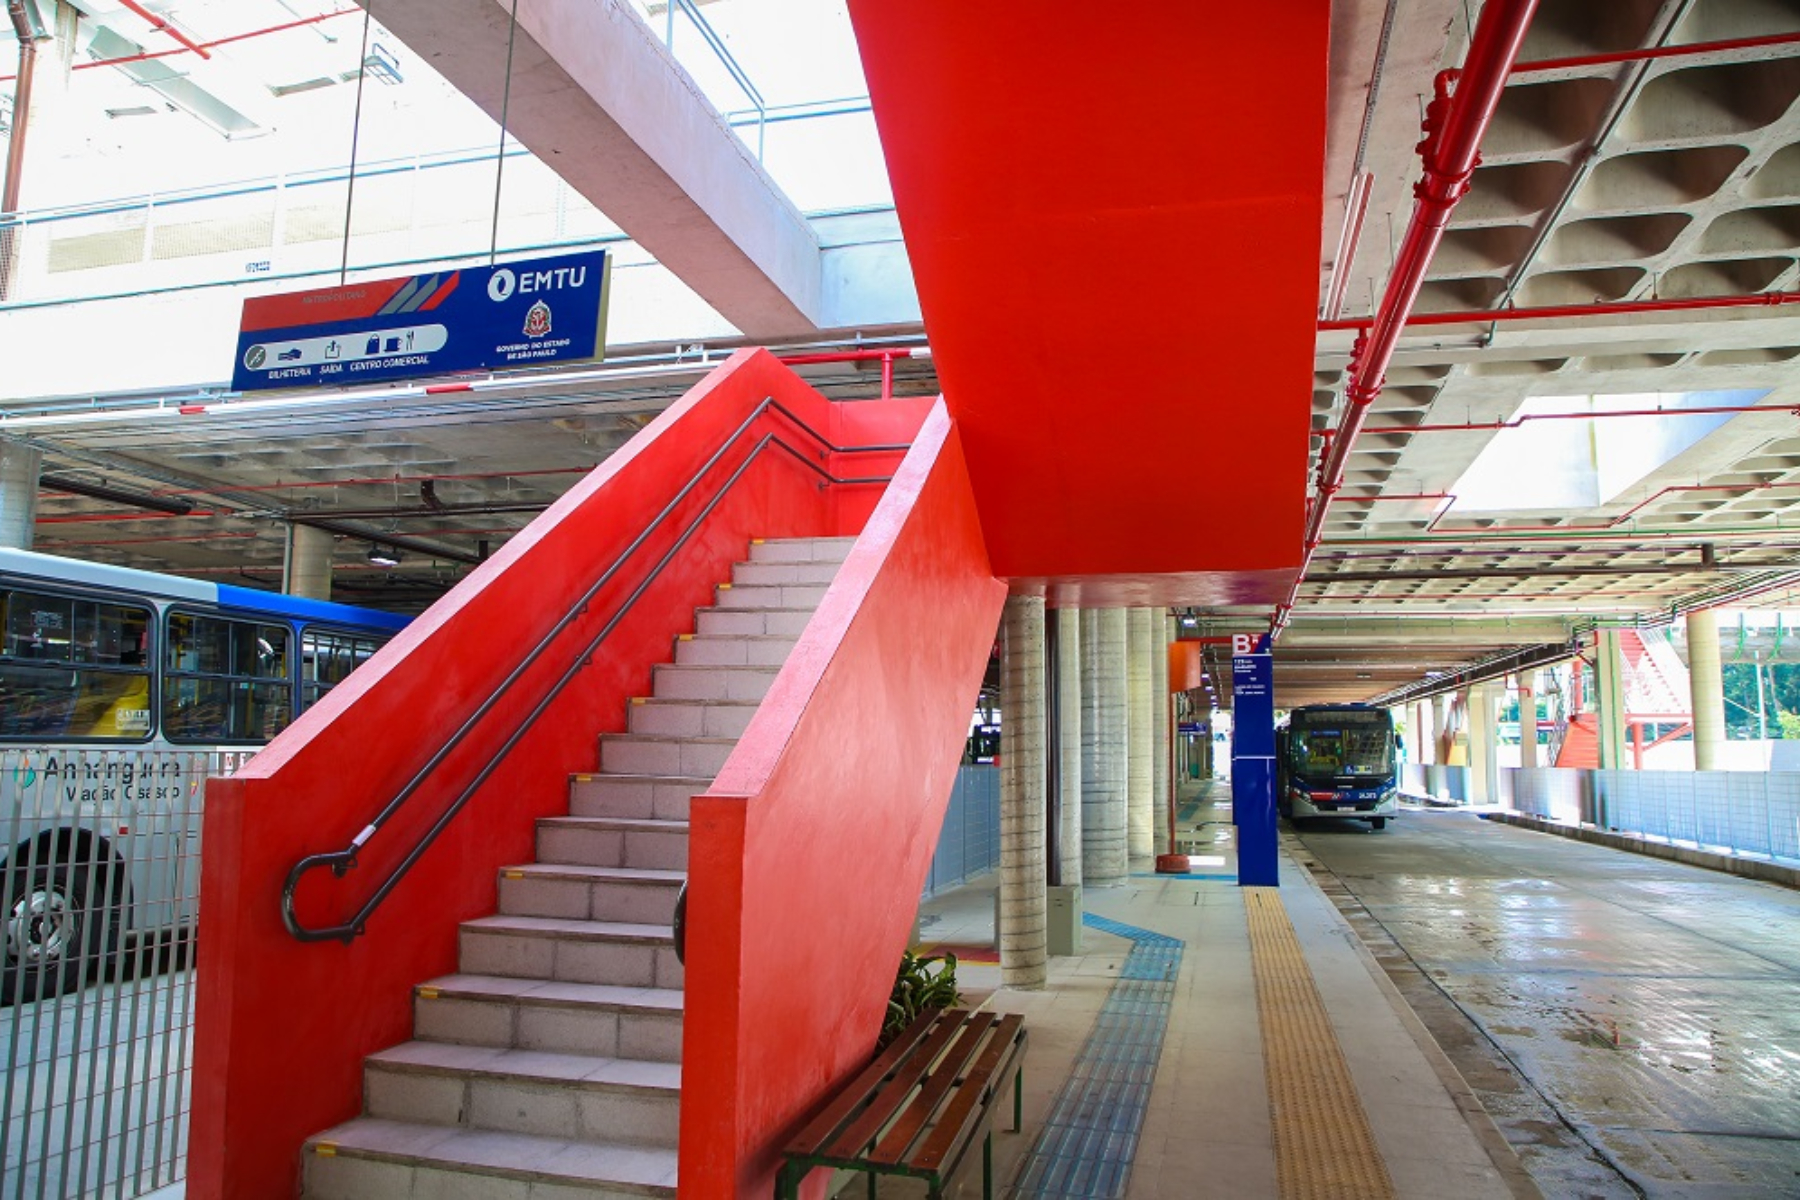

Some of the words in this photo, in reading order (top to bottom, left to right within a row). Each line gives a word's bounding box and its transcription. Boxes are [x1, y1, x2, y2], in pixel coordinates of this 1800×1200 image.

[519, 266, 586, 293] EMTU
[496, 342, 530, 353] GOVERNO
[531, 341, 543, 350] DO
[543, 338, 571, 348] ESTADO
[507, 352, 517, 361] DE
[532, 348, 557, 358] PAULO
[350, 359, 382, 372] CENTRO
[383, 354, 430, 368] COMERCIAL
[268, 367, 312, 380] BILHETERIA
[1232, 633, 1252, 654] B
